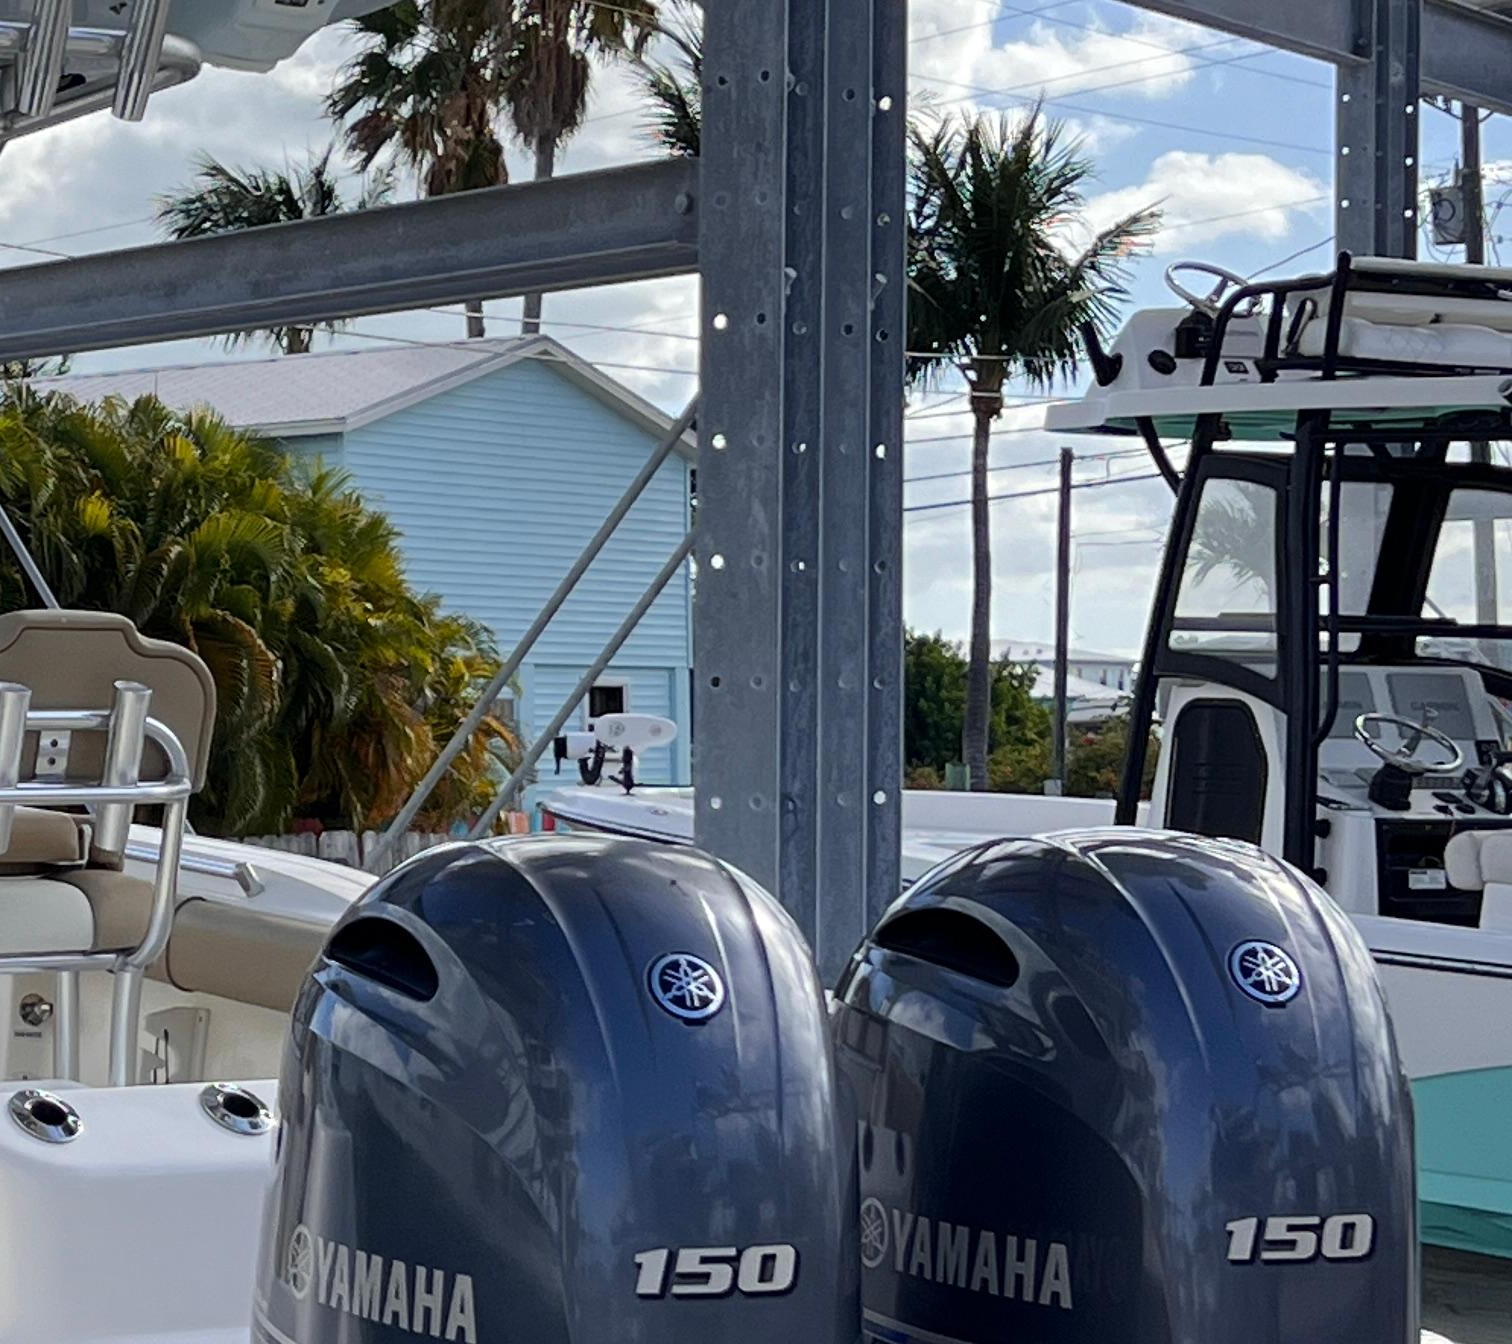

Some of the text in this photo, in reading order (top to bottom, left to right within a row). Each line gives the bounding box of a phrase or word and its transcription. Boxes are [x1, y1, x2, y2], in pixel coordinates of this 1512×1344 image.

[892, 1208, 1073, 1310] YAMAHA
[1225, 1212, 1375, 1262] 150
[633, 1243, 798, 1297] 150
